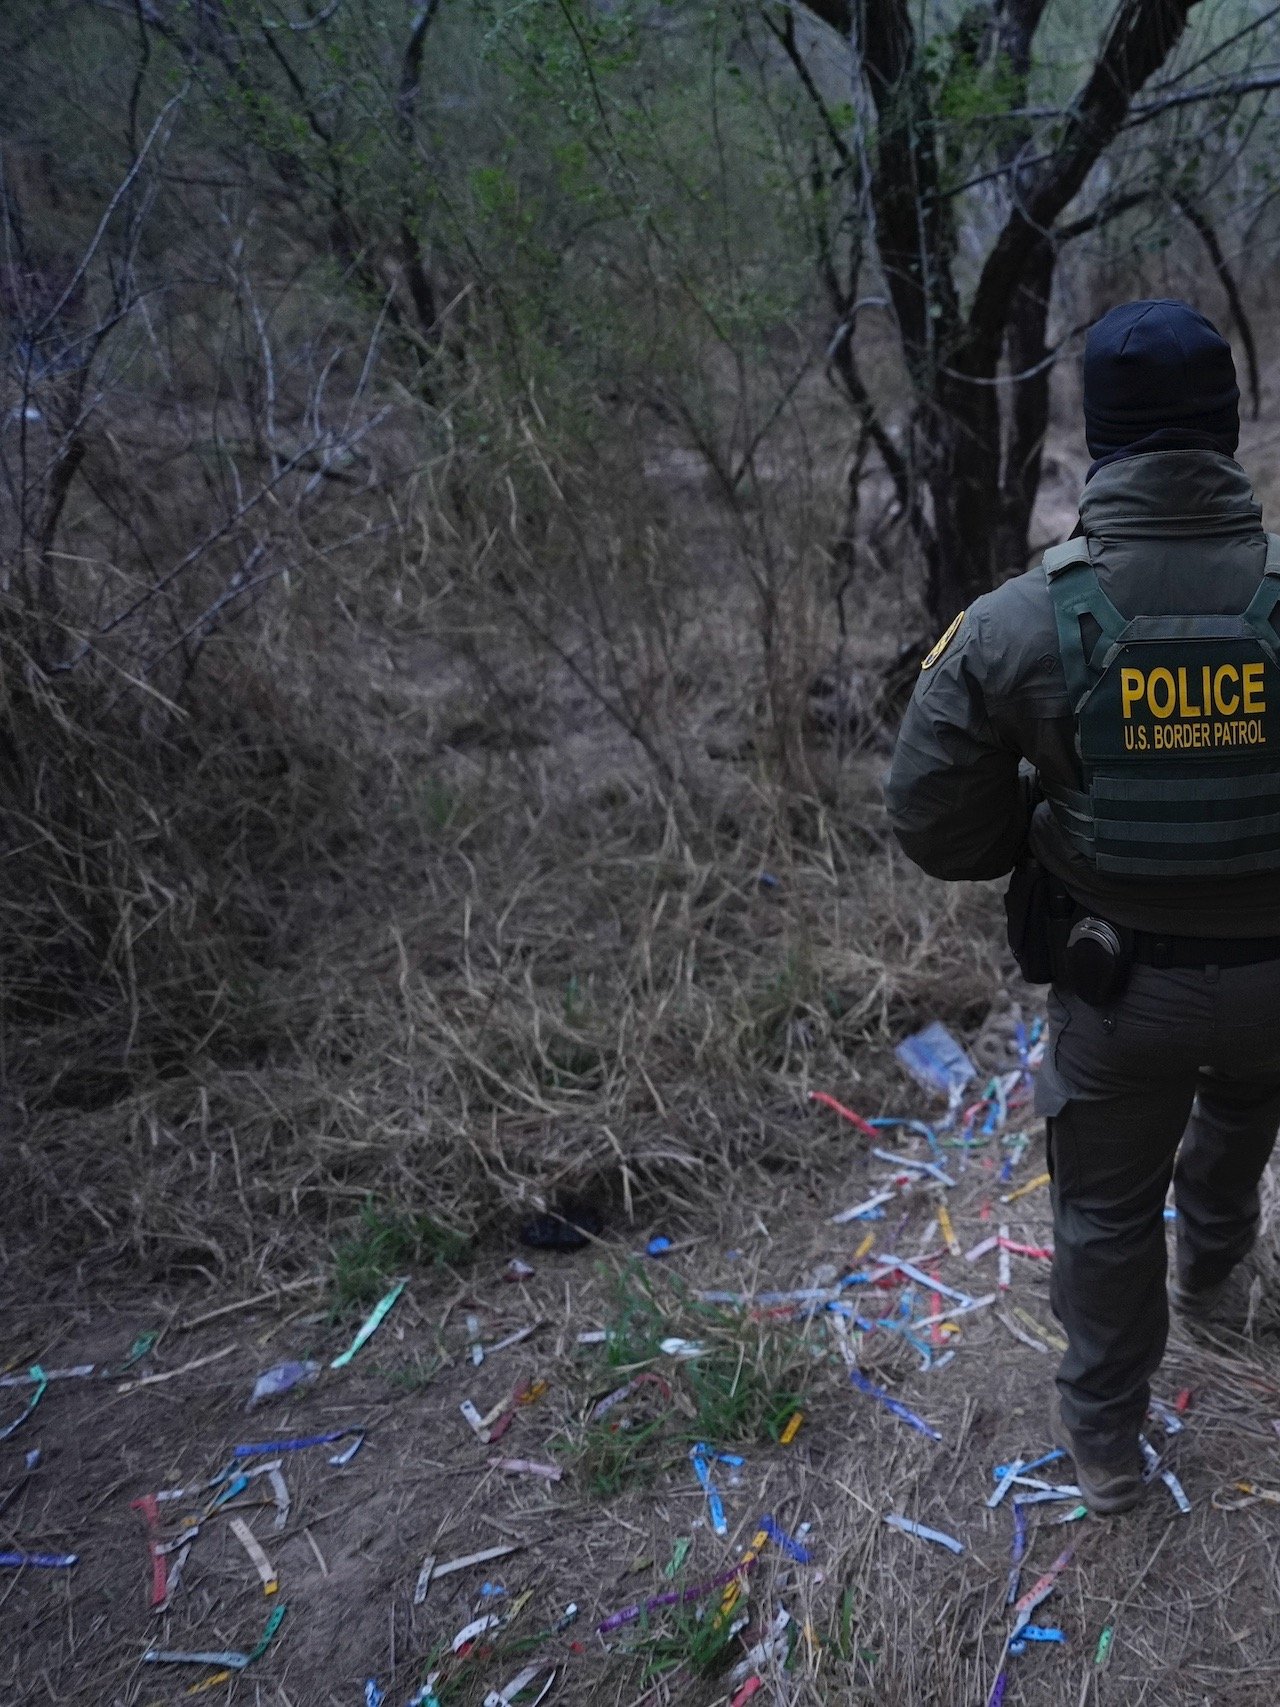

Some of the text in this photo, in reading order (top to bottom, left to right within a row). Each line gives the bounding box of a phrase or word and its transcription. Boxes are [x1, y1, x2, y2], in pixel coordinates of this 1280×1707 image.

[1120, 662, 1266, 719] POLICE
[1124, 719, 1266, 750] U.S. BORDER PATROL
